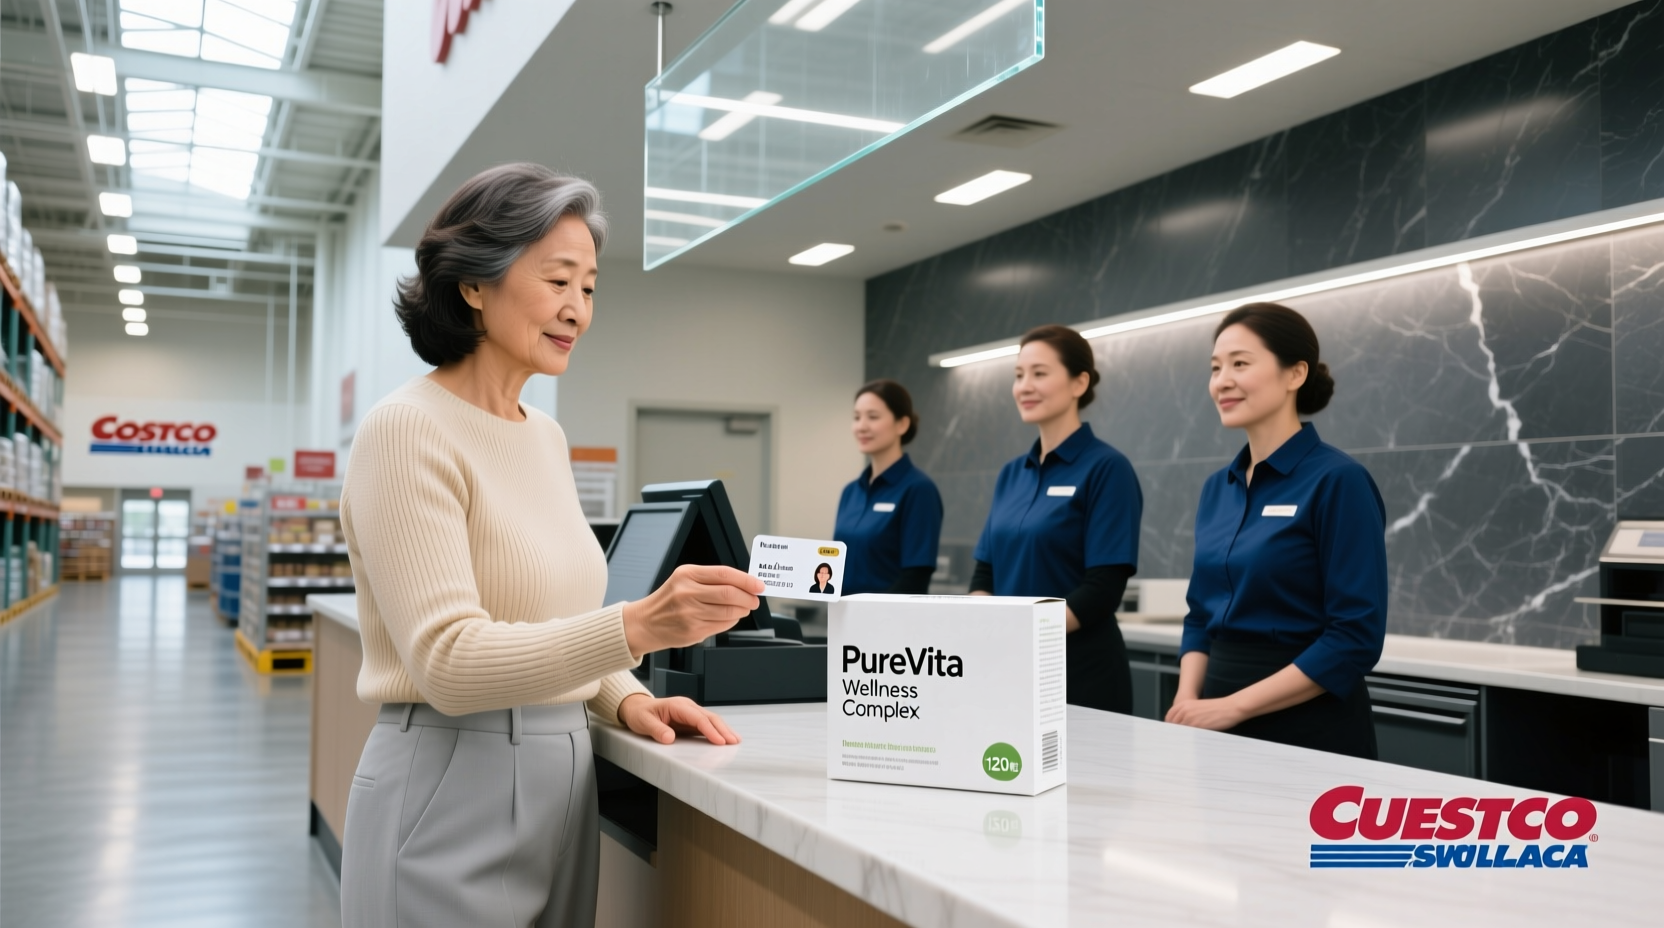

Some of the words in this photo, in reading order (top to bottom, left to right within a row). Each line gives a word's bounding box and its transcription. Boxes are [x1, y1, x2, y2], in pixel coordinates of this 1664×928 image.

[91, 416, 217, 442] COSTCO
[842, 645, 963, 677] PureVita
[842, 678, 919, 698] Wellness
[842, 699, 920, 722] Complex
